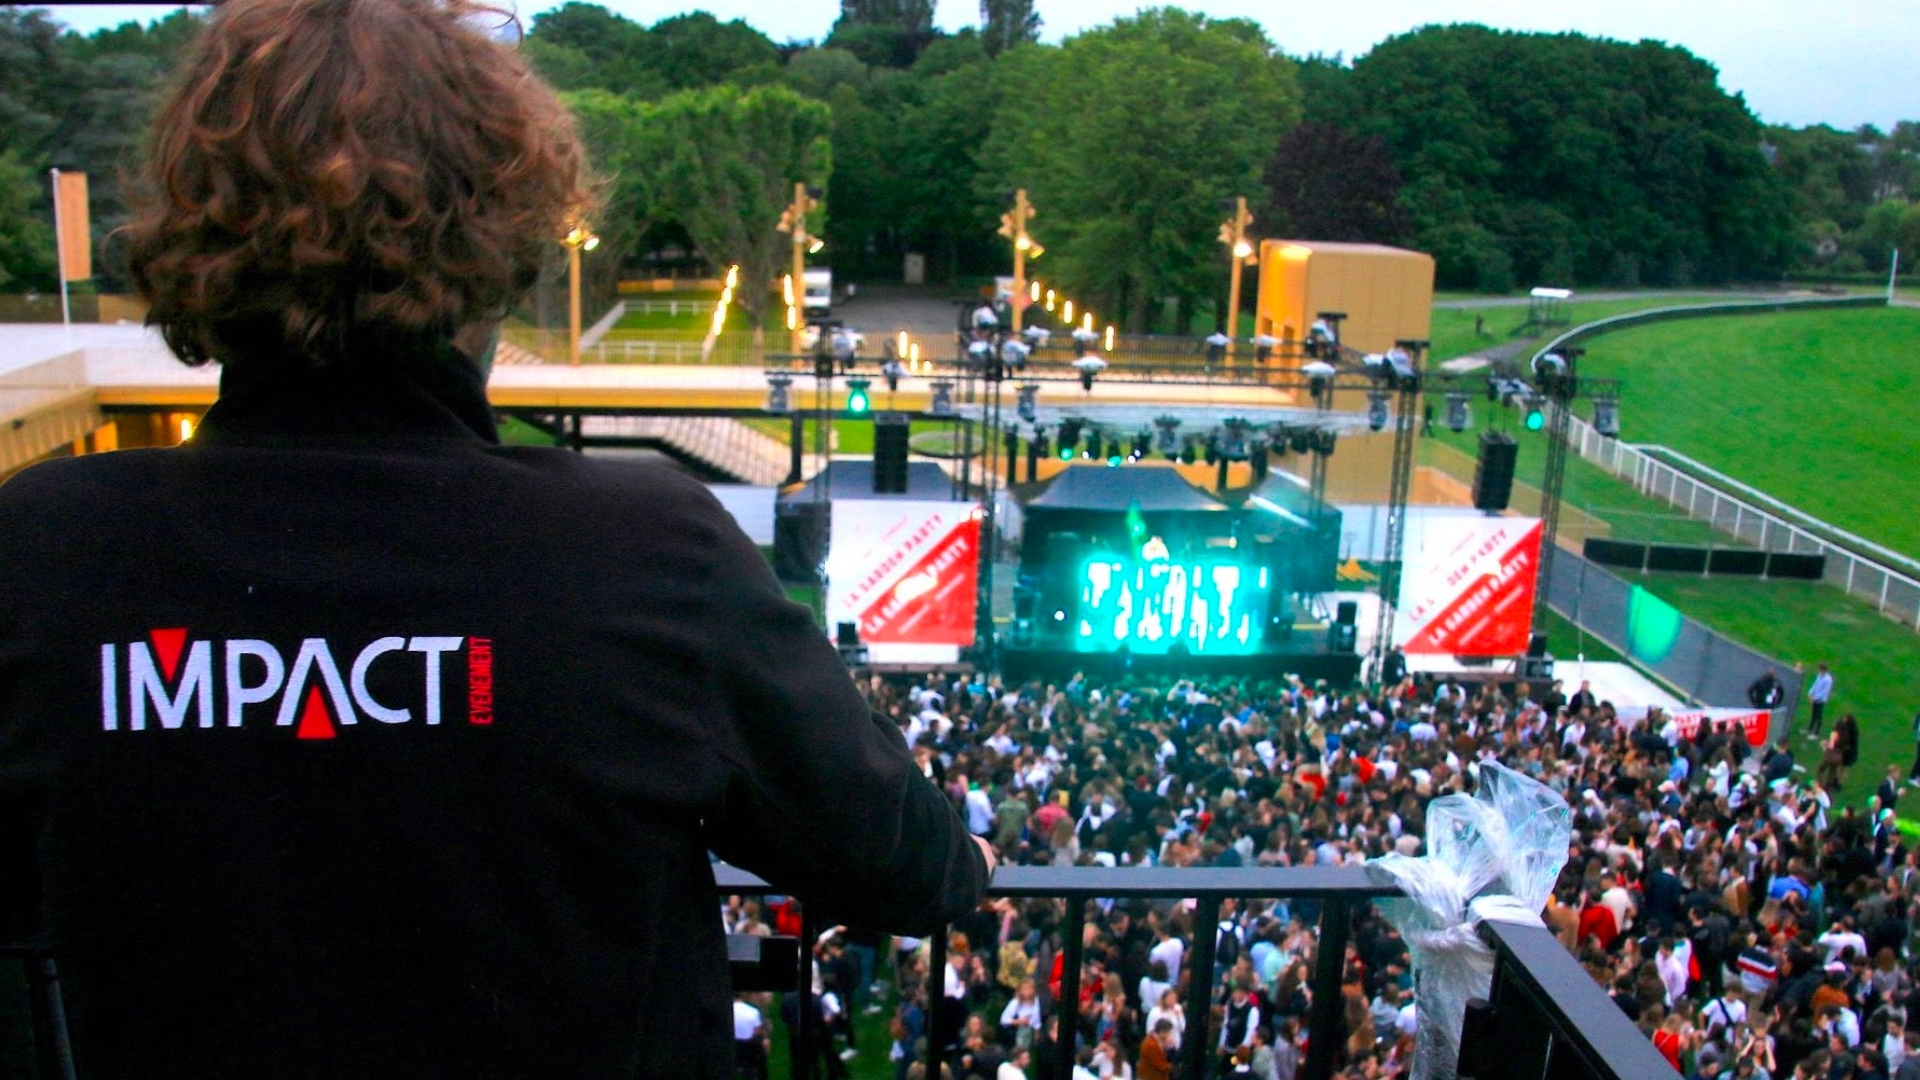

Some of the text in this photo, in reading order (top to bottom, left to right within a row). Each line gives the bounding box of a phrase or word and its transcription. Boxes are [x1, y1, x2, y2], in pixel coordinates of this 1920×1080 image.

[905, 512, 943, 551] PARTY
[865, 616, 886, 634] LA
[1428, 627, 1447, 646] LA
[1445, 587, 1490, 630] GARDEN
[1489, 552, 1529, 590] PARTY
[101, 632, 465, 735] IMPACT
[468, 636, 493, 724] EVENEMENT
